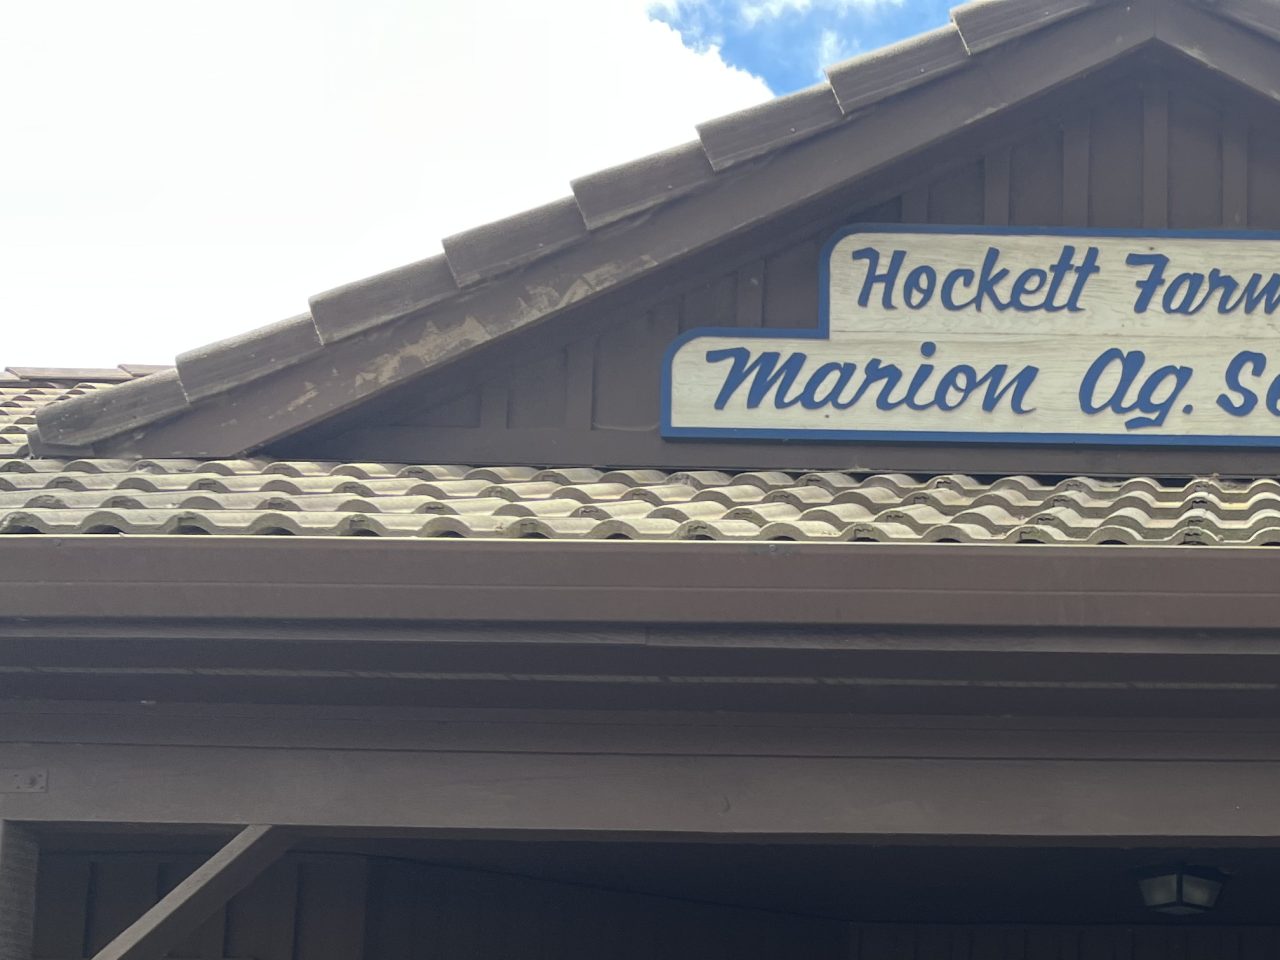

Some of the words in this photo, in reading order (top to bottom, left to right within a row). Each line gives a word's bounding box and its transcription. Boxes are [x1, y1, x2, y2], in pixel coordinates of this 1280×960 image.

[853, 245, 1100, 313] Hockett
[706, 342, 1038, 414] Marion
[1079, 348, 1194, 429] Ag.
